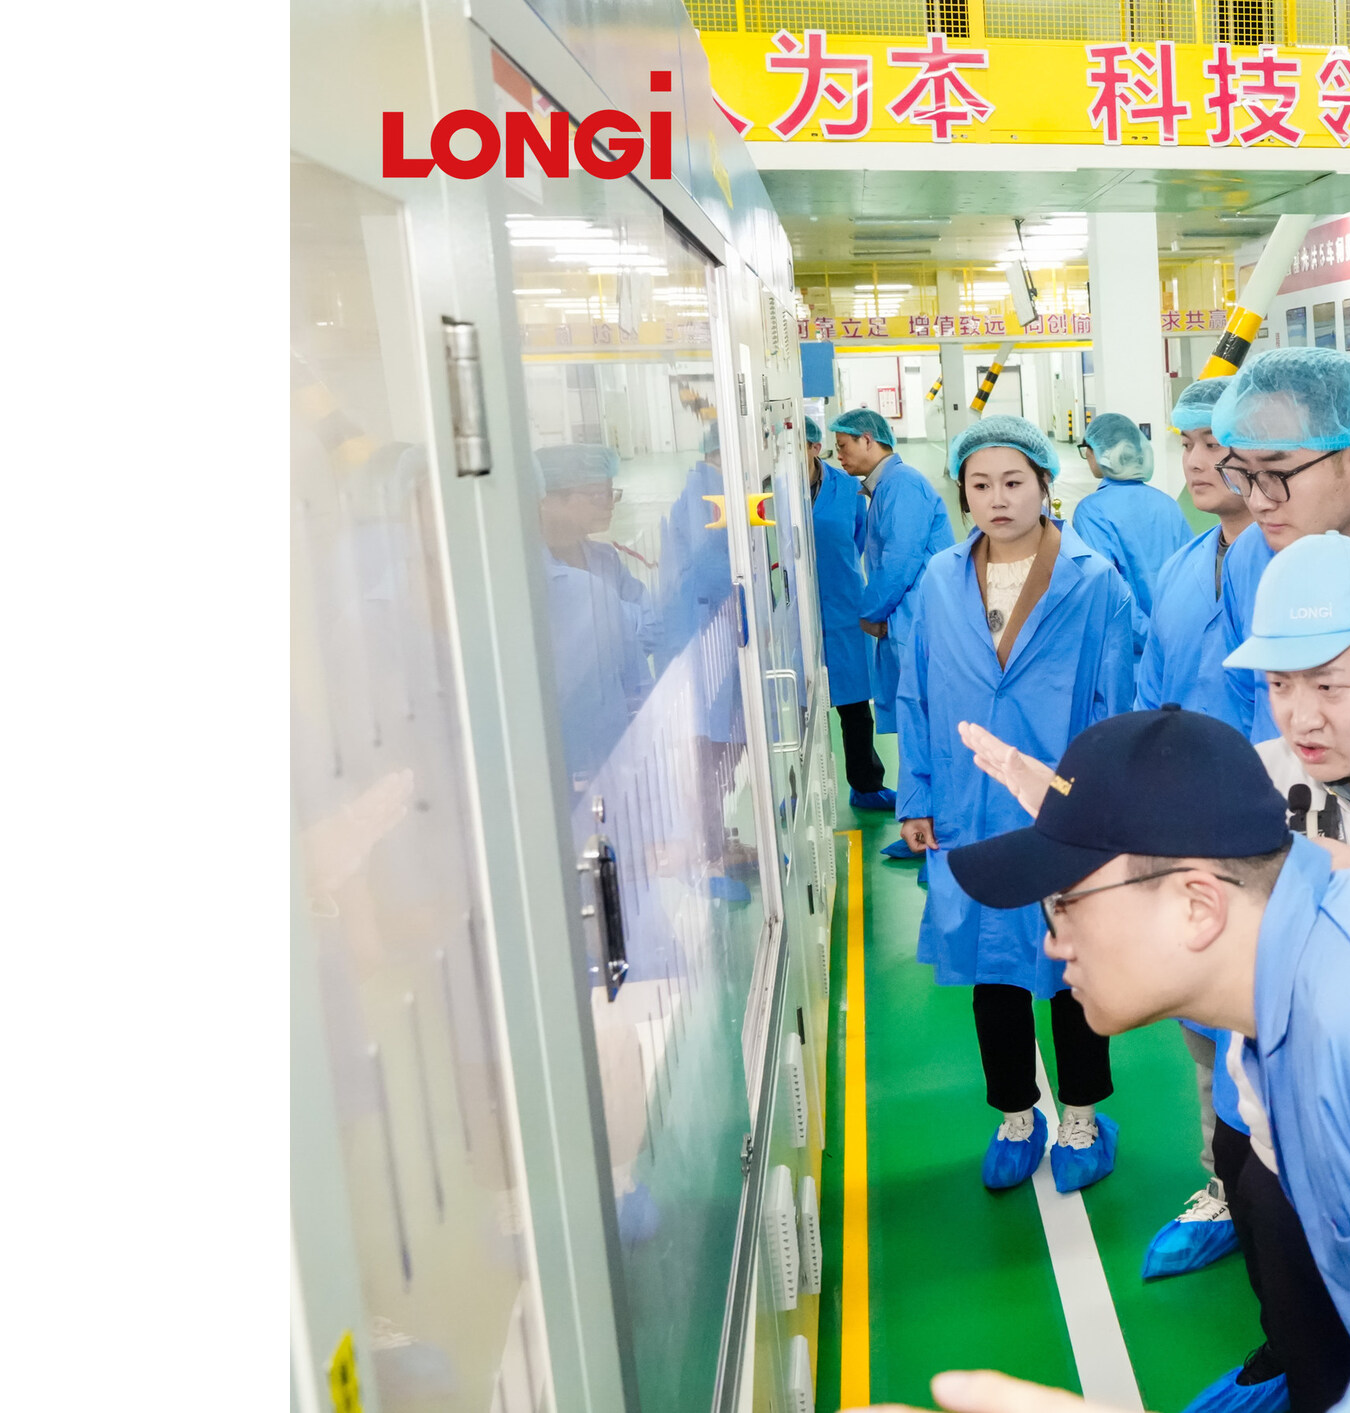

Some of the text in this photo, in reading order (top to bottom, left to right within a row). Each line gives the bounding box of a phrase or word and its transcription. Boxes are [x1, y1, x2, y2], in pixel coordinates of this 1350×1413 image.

[712, 29, 993, 142] 为本
[909, 313, 1006, 337] 增值致远
